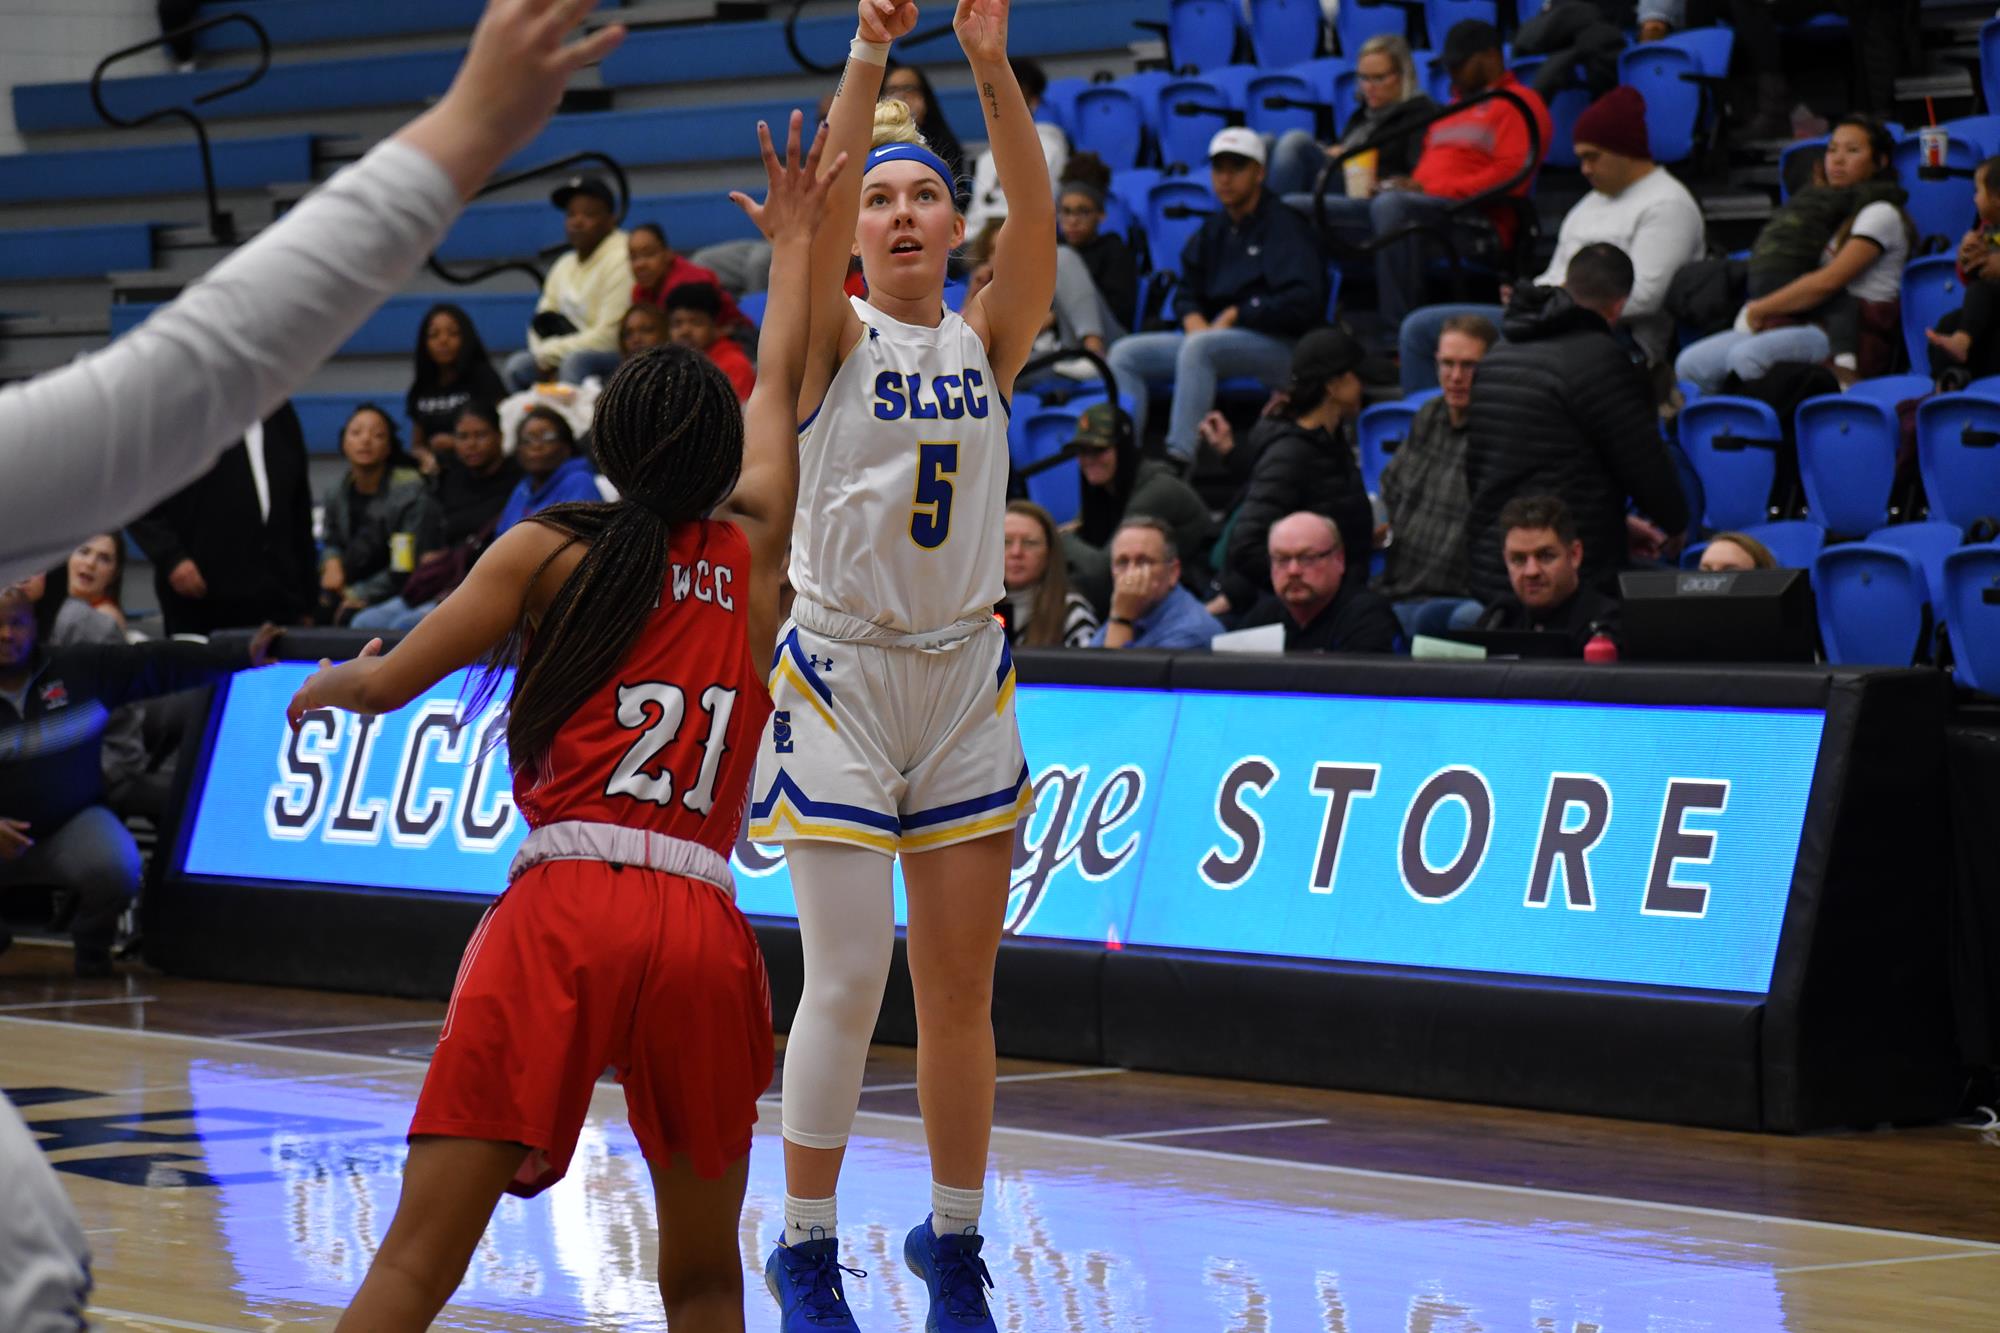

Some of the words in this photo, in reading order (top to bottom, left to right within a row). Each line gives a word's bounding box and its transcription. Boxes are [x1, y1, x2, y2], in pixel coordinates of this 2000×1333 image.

[873, 367, 990, 421] SLCC
[908, 440, 961, 551] 5
[653, 559, 735, 613] WCC
[603, 681, 738, 818] 21
[264, 699, 518, 853] SLCC
[1198, 754, 1731, 919] STORE
